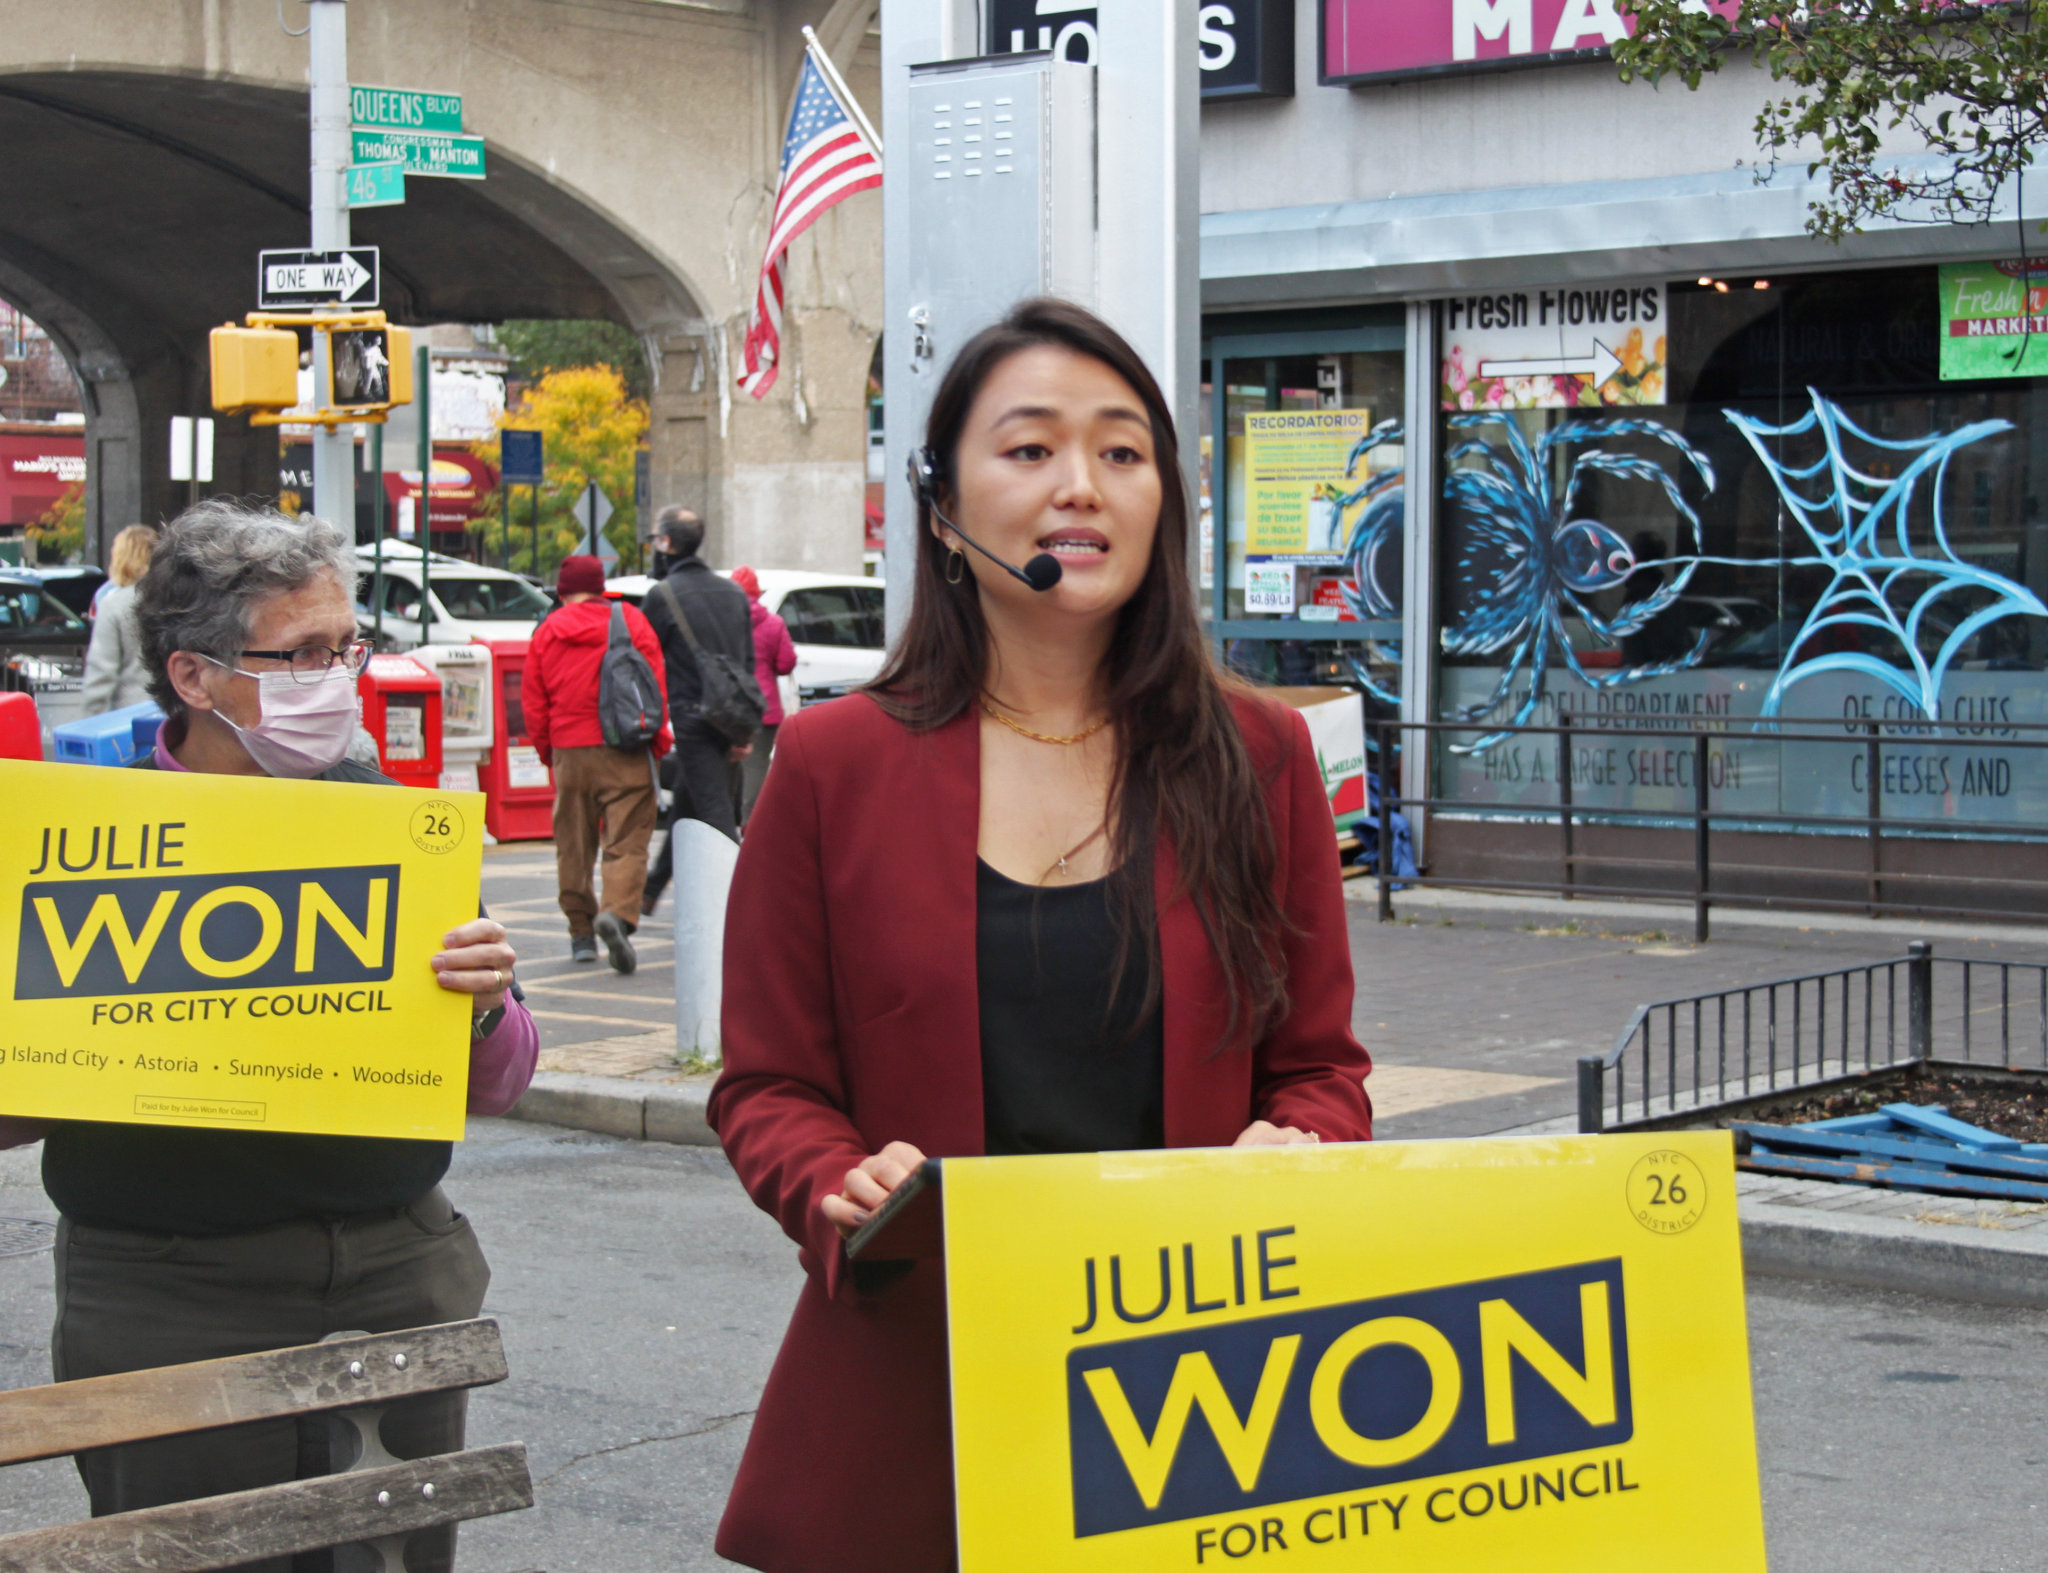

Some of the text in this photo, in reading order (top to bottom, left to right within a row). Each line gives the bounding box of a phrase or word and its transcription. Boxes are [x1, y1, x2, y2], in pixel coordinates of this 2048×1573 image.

[352, 89, 460, 126] QUEENS BLVD
[357, 141, 408, 161] THOMAS
[429, 147, 479, 166] MANTON
[382, 134, 453, 148] CONGRESSMAN
[351, 167, 393, 200] 46 ST
[403, 160, 449, 173] ULEVARD
[276, 267, 359, 289] ONE WAY
[1953, 276, 2017, 315] Fresh
[1449, 287, 1658, 330] Fresh Flowers
[1250, 414, 1364, 430] RECORDATORIO:
[1597, 692, 1732, 730] DEPARTMENT
[1844, 694, 1873, 734] OF
[1954, 696, 2018, 739] CUTS,
[1484, 745, 1522, 781] HAS
[1531, 746, 1545, 783] A
[1627, 748, 1741, 791] SELECON
[1851, 754, 2012, 797] CEESES AND
[428, 801, 450, 811] NYC
[424, 814, 450, 836] 26
[30, 822, 186, 875] JULIE
[415, 836, 457, 852] DISTRICT
[33, 877, 389, 988] WON
[92, 990, 392, 1025] FOR CITY COUNCIL
[12, 1046, 68, 1065] Island
[72, 1049, 109, 1071] City
[134, 1054, 199, 1073] Astoria
[229, 1059, 324, 1082] Sunnyside
[352, 1066, 443, 1087] Woodside
[141, 1102, 259, 1116] Paid for by Julie Won for Council
[1648, 1153, 1680, 1166] NYC
[1646, 1173, 1687, 1205] 26
[1638, 1208, 1697, 1231] DISTRICT
[1072, 1225, 1300, 1335] JULIE
[1082, 1279, 1618, 1511] WON
[1195, 1457, 1640, 1564] FOR CITY COUNCIL
